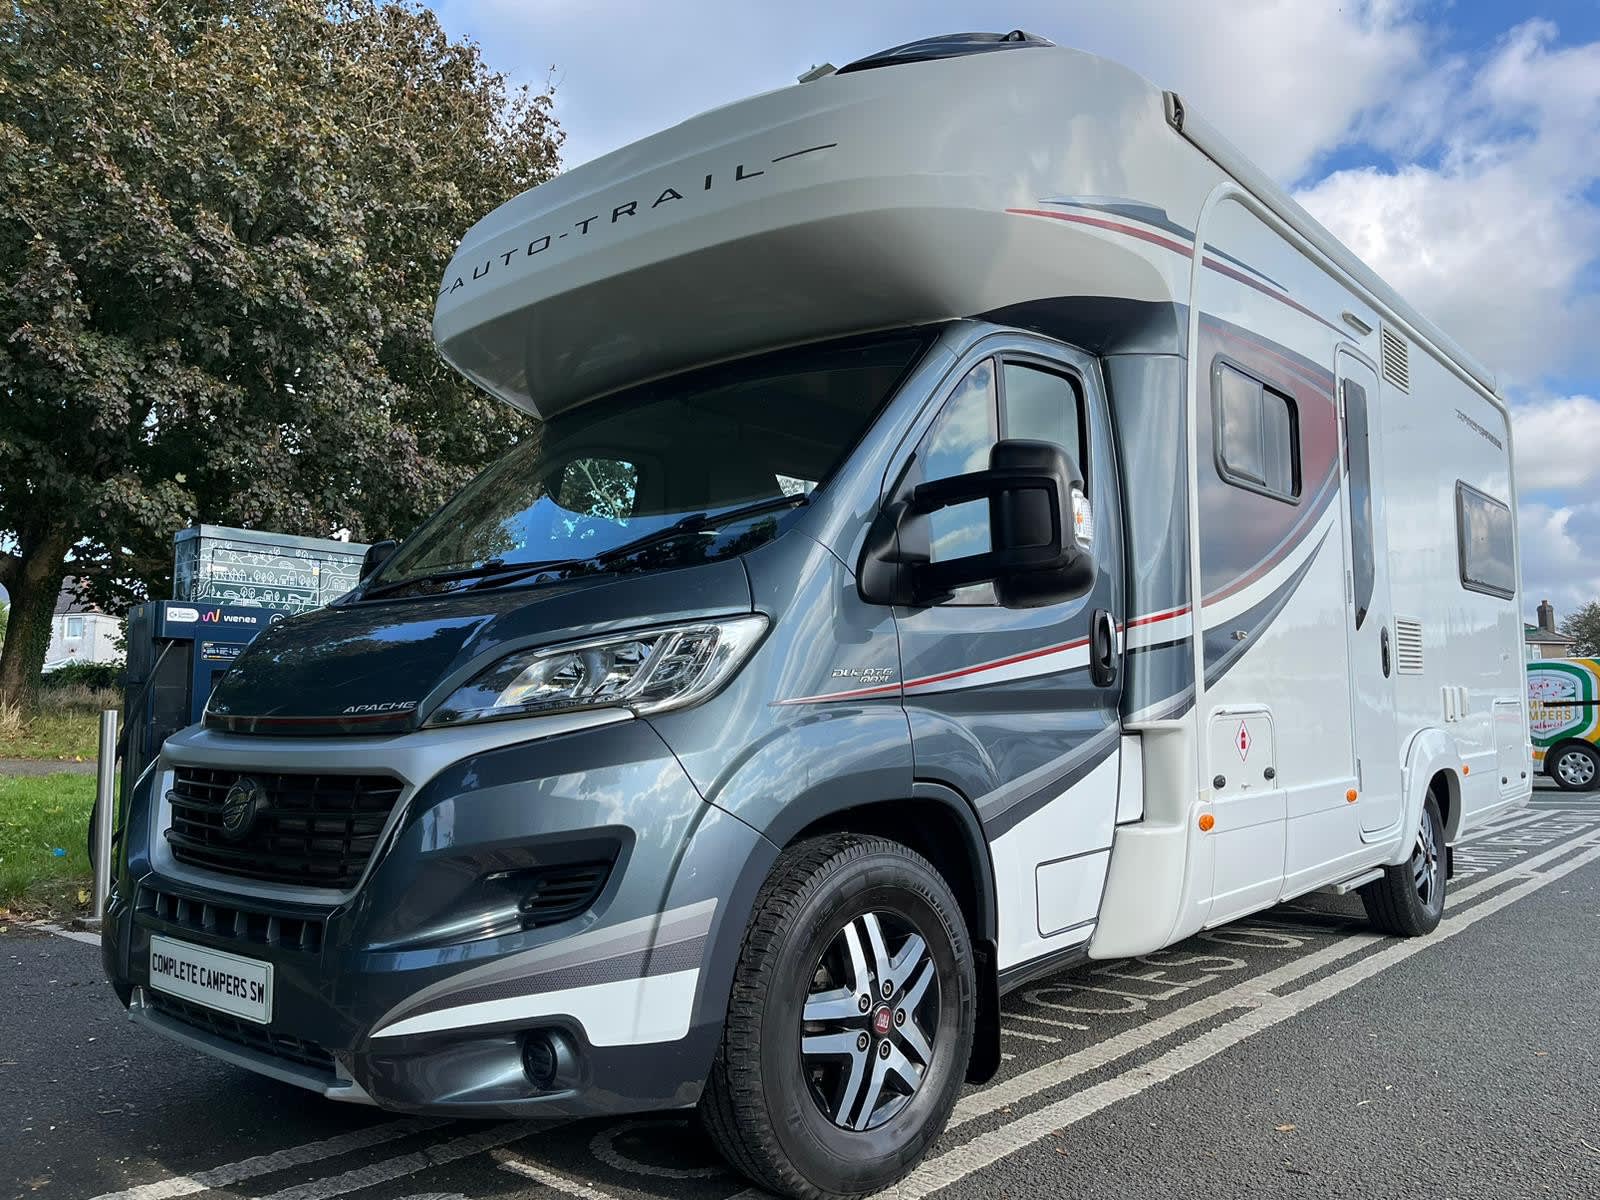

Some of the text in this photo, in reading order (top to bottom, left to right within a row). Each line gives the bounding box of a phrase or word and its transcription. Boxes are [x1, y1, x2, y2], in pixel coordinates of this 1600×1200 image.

[449, 164, 765, 295] AUTO-TRAIL
[223, 614, 257, 624] wenea
[342, 700, 417, 714] APACHE
[1530, 710, 1572, 721] MPERS
[152, 953, 198, 984] COMPLETE
[200, 967, 247, 999] CAMPERS
